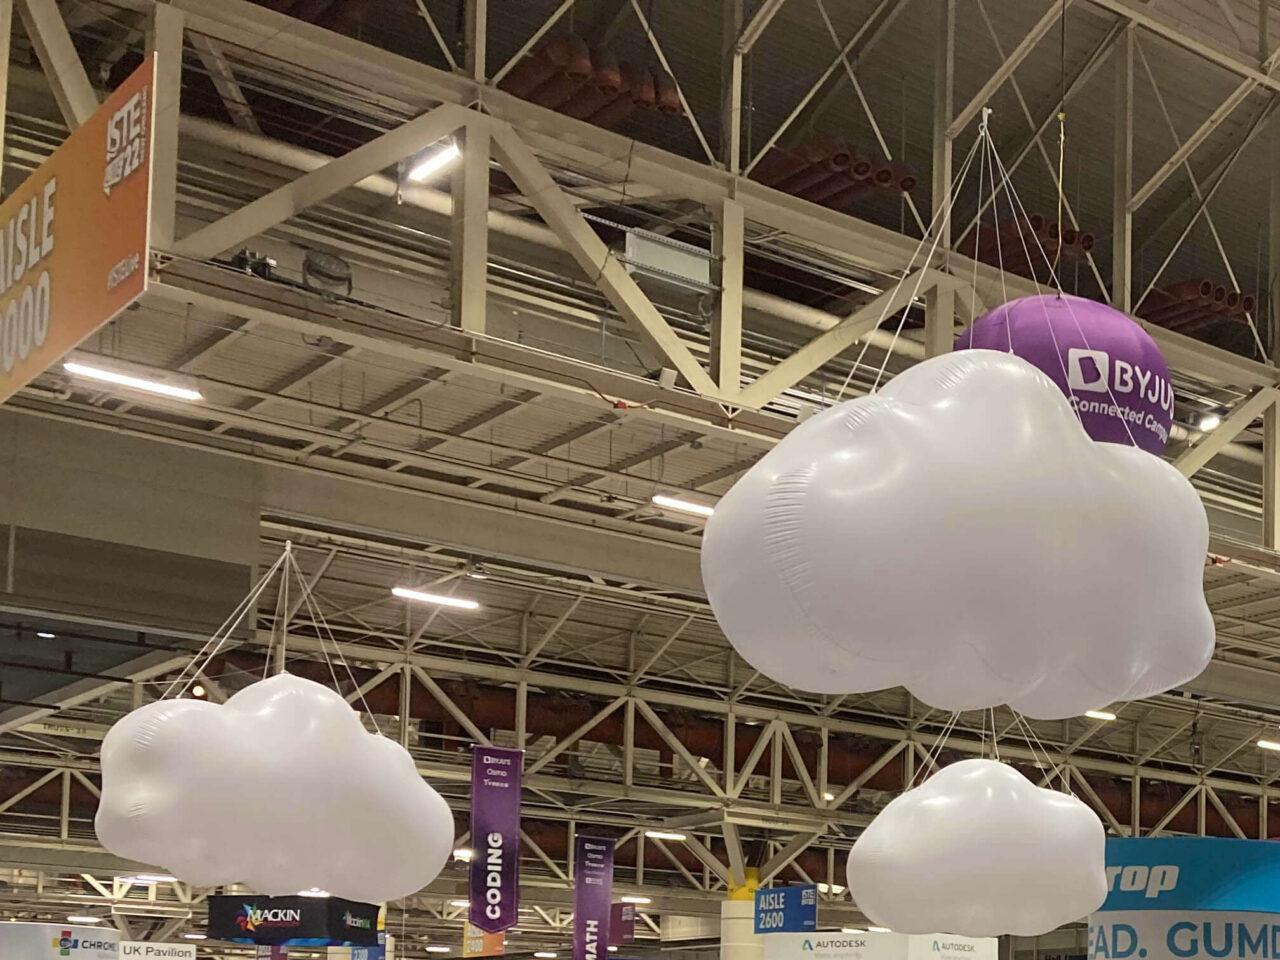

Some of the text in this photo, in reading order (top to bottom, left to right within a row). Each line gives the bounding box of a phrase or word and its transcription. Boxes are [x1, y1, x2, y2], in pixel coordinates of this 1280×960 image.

[0, 271, 50, 372] 000
[1068, 395, 1145, 425] Connected
[485, 832, 503, 920] CODING
[759, 893, 785, 911] AISLE
[248, 909, 301, 924] MACKIN
[759, 911, 784, 929] 2600
[123, 946, 192, 958] UK Pavilion
[816, 940, 867, 949] AUTODESK
[941, 943, 975, 952] AUTODESK
